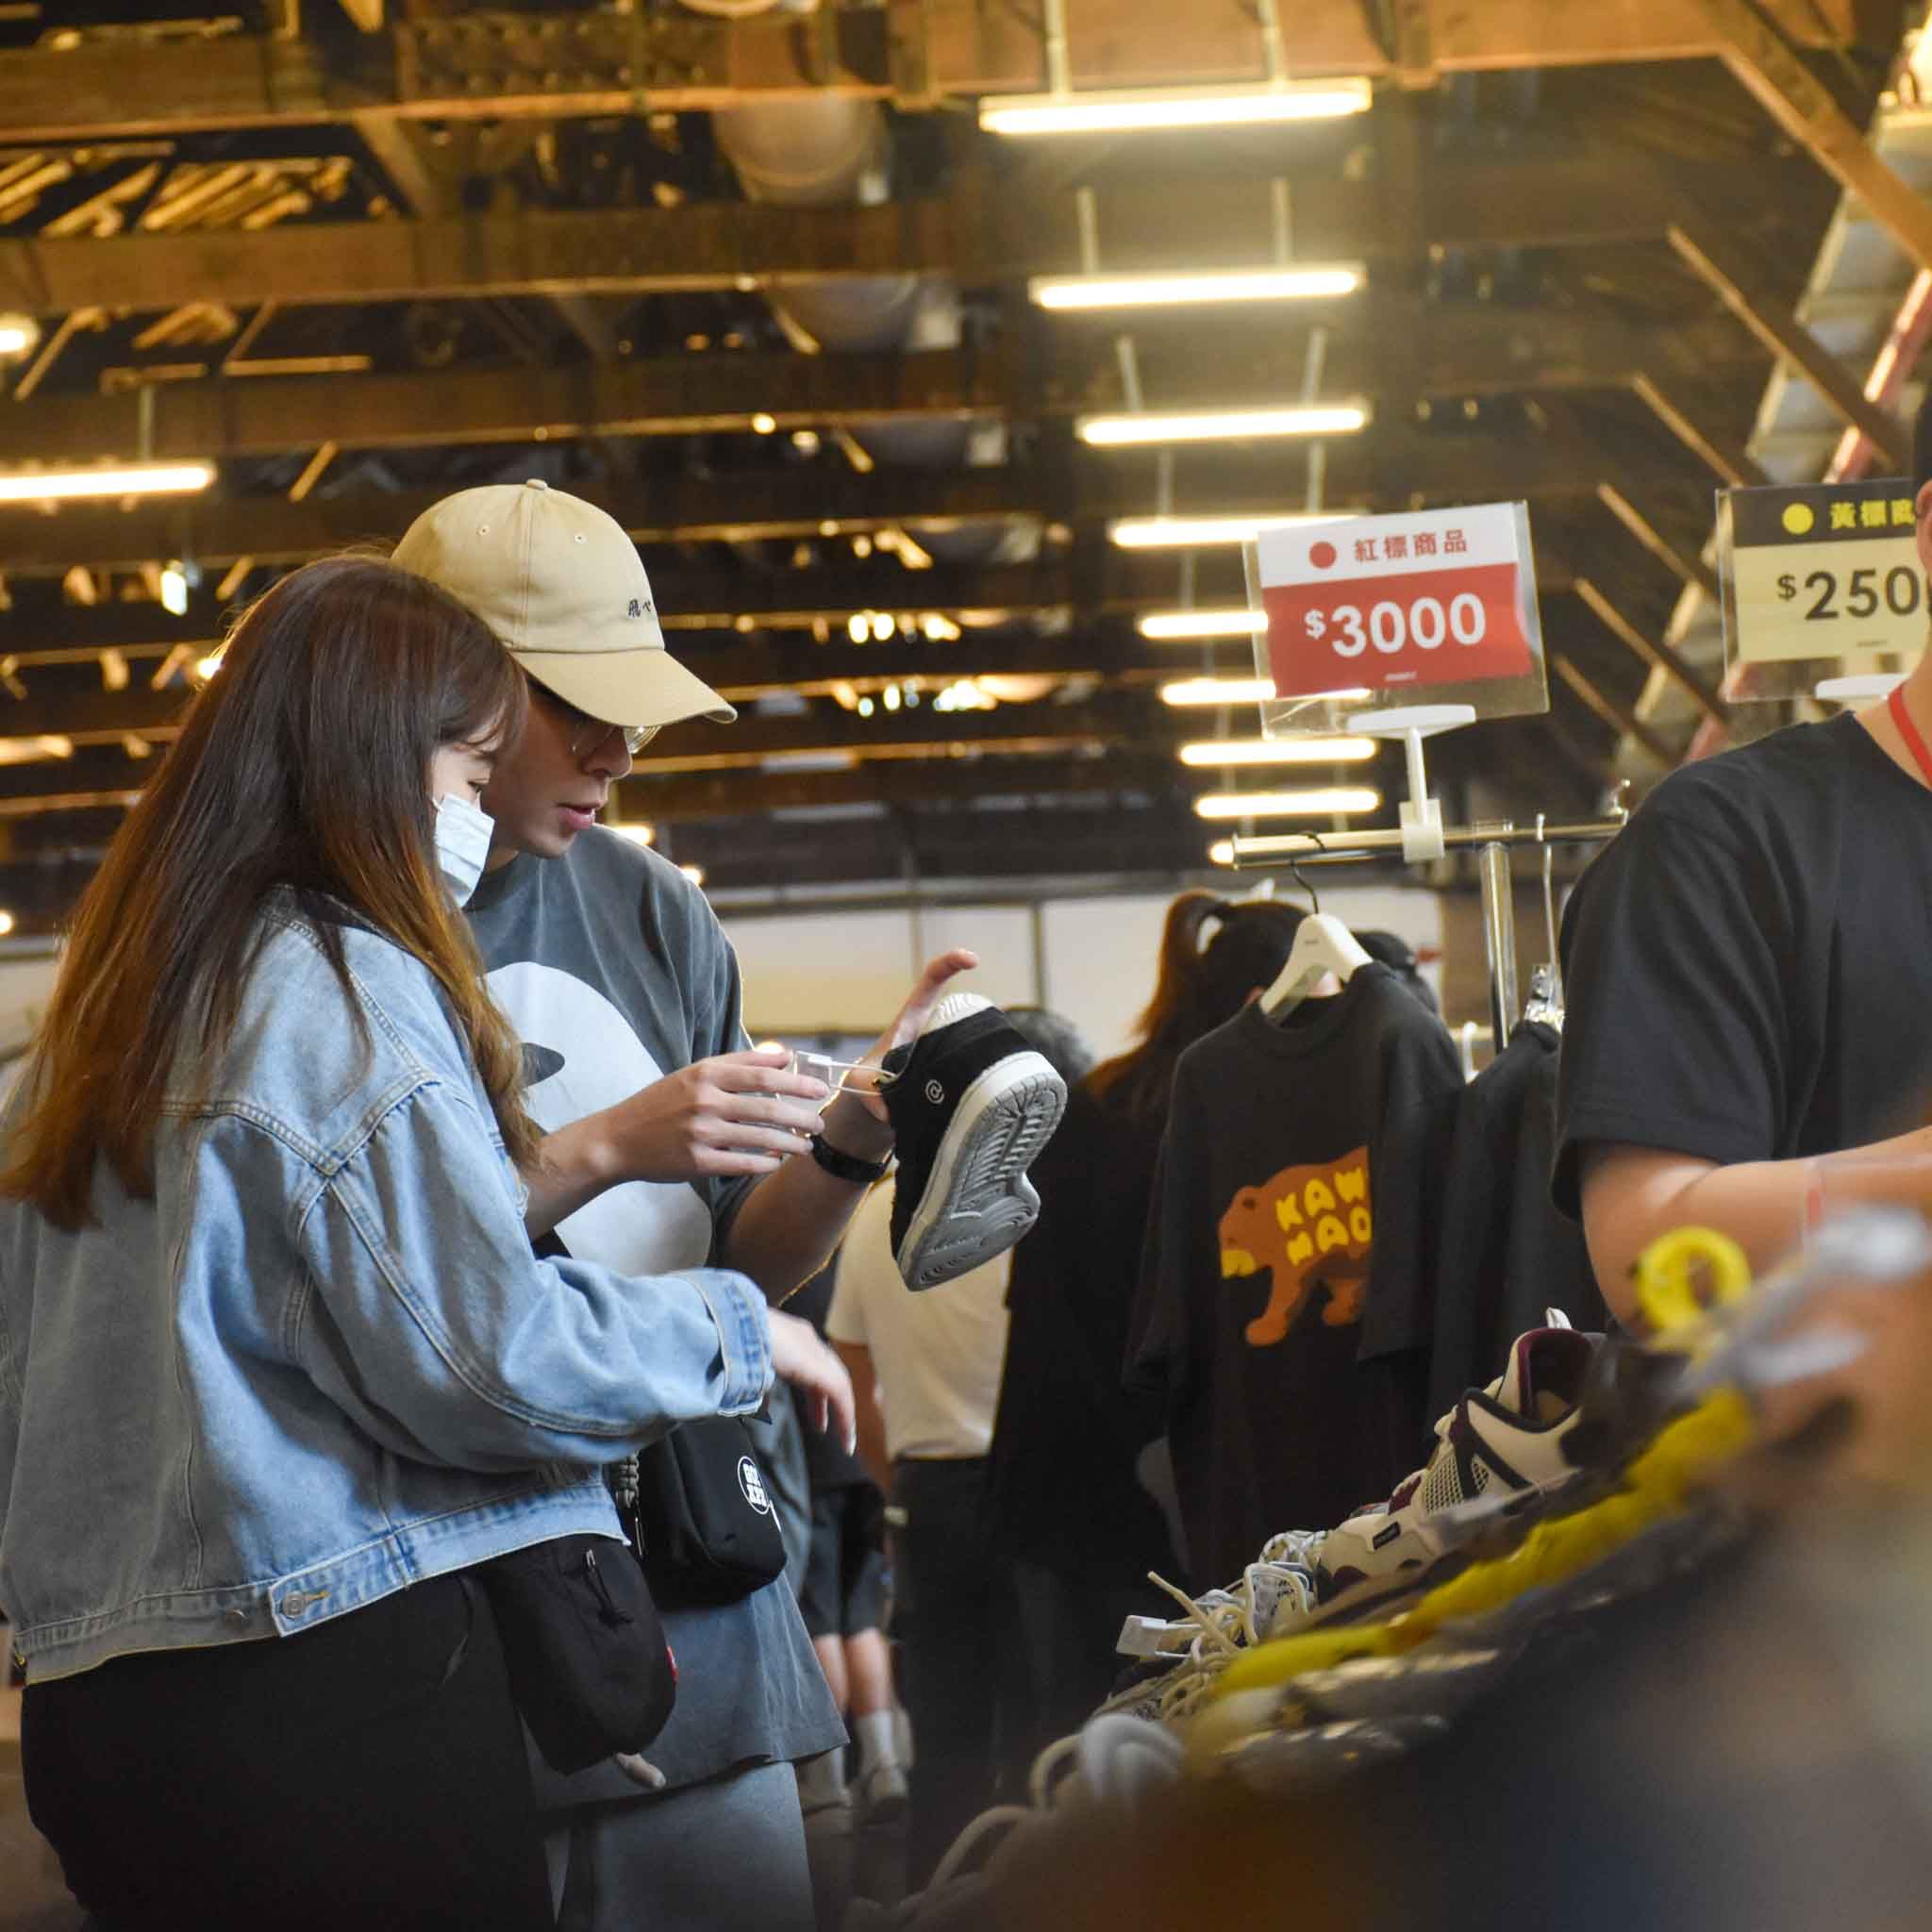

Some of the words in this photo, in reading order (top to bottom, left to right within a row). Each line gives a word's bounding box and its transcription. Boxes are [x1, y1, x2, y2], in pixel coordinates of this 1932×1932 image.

[1355, 528, 1468, 562] 紅標商品
[1304, 592, 1487, 658] $3000
